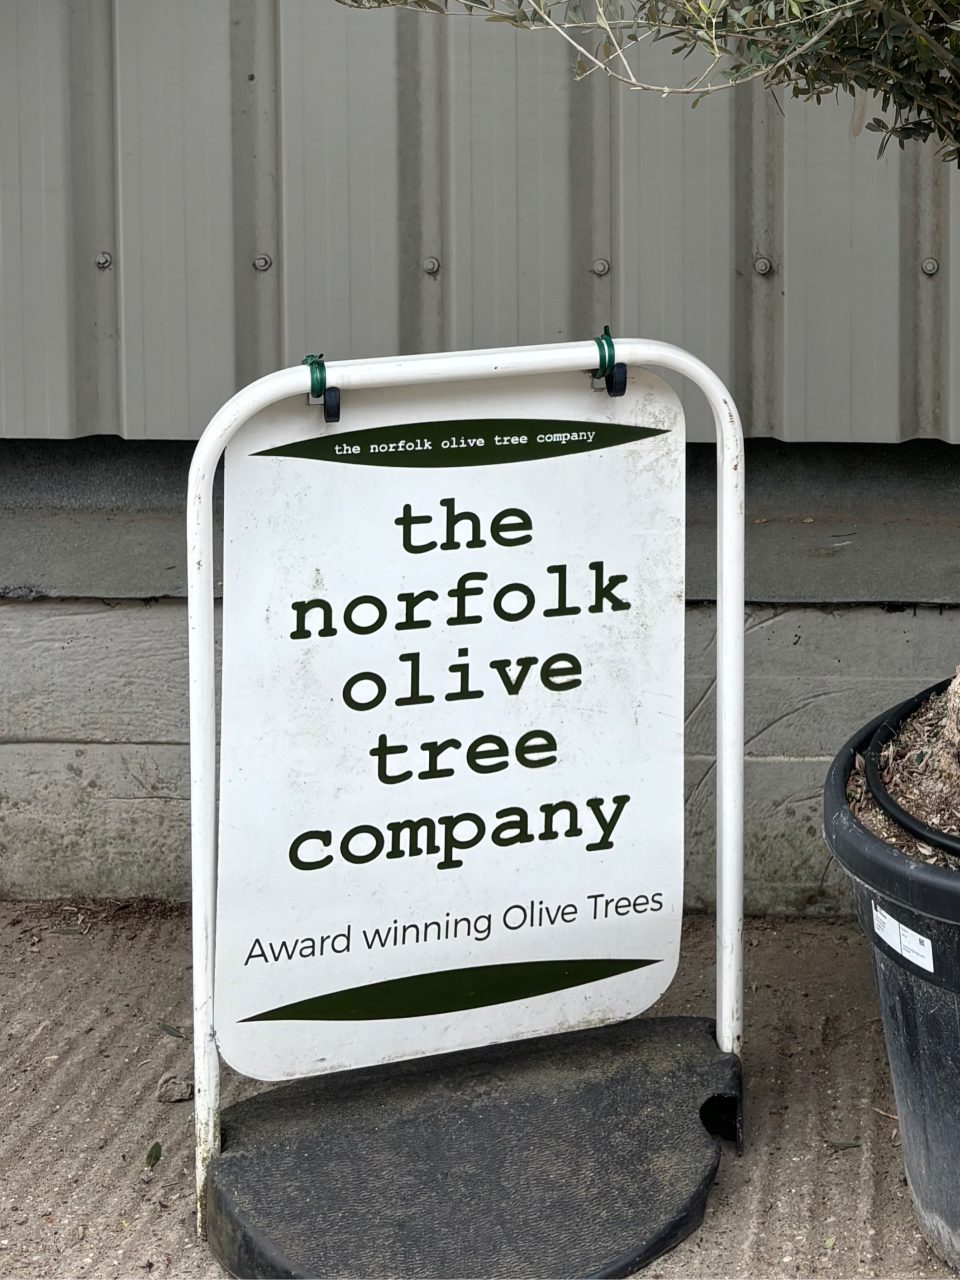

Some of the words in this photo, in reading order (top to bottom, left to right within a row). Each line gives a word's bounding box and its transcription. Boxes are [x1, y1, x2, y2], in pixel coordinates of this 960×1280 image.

[334, 443, 361, 455] the
[369, 438, 433, 453] norfolk
[441, 437, 485, 449] olive
[494, 434, 528, 446] tree
[536, 431, 596, 443] company
[394, 497, 534, 555] the
[289, 560, 632, 640] norfolk
[342, 647, 583, 712] olive
[369, 729, 559, 785] tree
[288, 794, 631, 871] company
[243, 924, 351, 966] Award
[362, 914, 492, 950] winning
[502, 900, 578, 931] Olive
[586, 892, 664, 921] Trees
